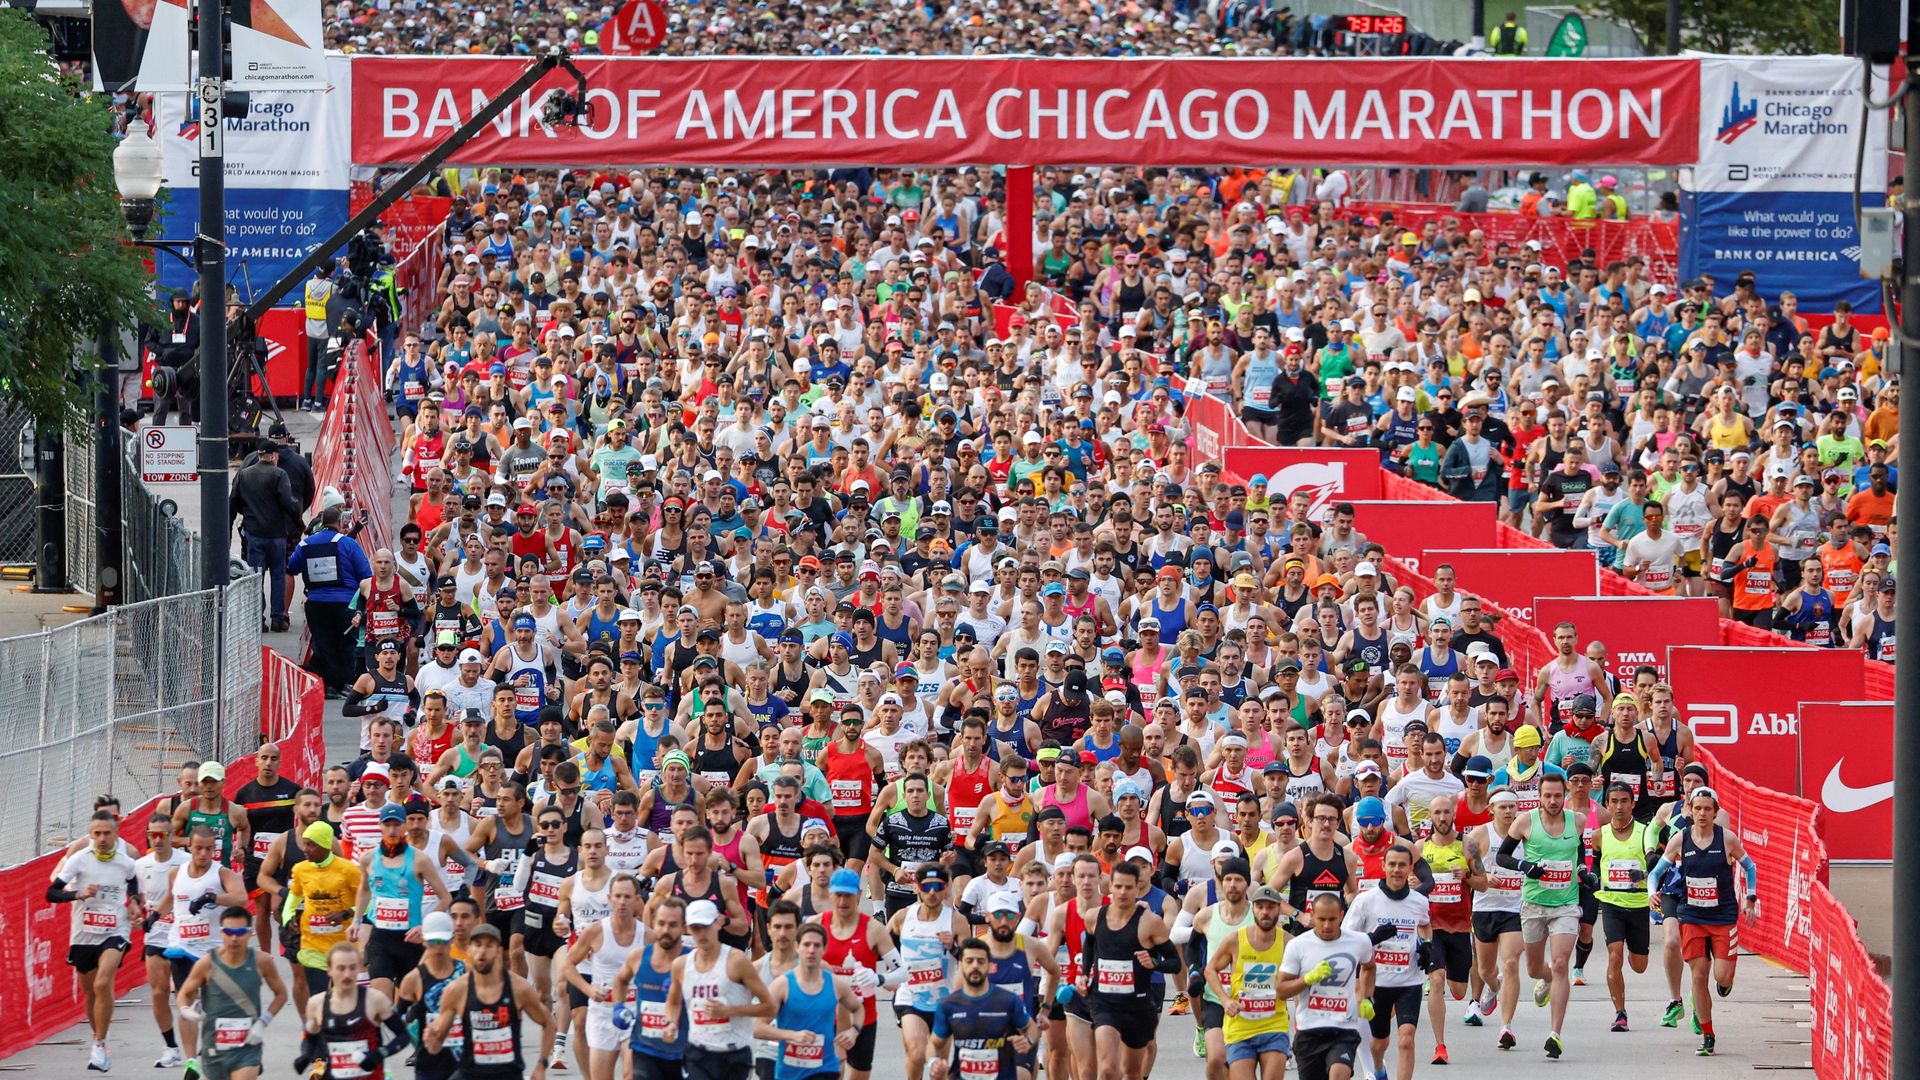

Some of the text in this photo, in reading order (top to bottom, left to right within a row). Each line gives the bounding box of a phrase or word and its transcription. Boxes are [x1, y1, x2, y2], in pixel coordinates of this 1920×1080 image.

[627, 3, 656, 36] A
[249, 100, 294, 116] icago
[1764, 102, 1833, 120] Chicago
[382, 88, 1662, 141] BANK OF AMERICA CHICAGO MARATHON
[227, 118, 310, 132] Marathon
[1764, 120, 1848, 135] Marathon
[243, 208, 279, 220] would
[282, 210, 303, 222] you
[1744, 211, 1840, 226] What would you
[240, 225, 275, 237] power
[280, 225, 292, 235] to
[296, 223, 317, 235] do?
[1728, 226, 1854, 240] like the power to do?
[242, 248, 303, 257] AMERICA
[1715, 250, 1838, 261] BANK OF AMERICA
[514, 457, 539, 465] Team
[145, 473, 193, 481] TOW ZONE
[1617, 653, 1656, 662] TATA
[915, 683, 940, 693] CES
[756, 714, 771, 723] AINE
[840, 789, 860, 797] 5015
[955, 817, 974, 825] A 254
[1548, 871, 1572, 879] 25187
[1609, 869, 1630, 878] A 252
[531, 883, 538, 891] A
[1437, 884, 1461, 892] 22146
[1687, 887, 1717, 897] A 3052
[497, 899, 503, 907] A
[83, 913, 117, 925] A 1053
[376, 909, 407, 918] A 25147
[1377, 917, 1397, 925] COSTA
[187, 924, 210, 935] 1010
[1374, 951, 1409, 962] A 25134
[908, 968, 941, 982] A 1120
[1099, 972, 1132, 982] A 5073
[1248, 999, 1275, 1010] 10030
[1309, 997, 1347, 1009] A 4070
[785, 1046, 823, 1057] A 8007
[961, 1060, 998, 1072] A 1122
